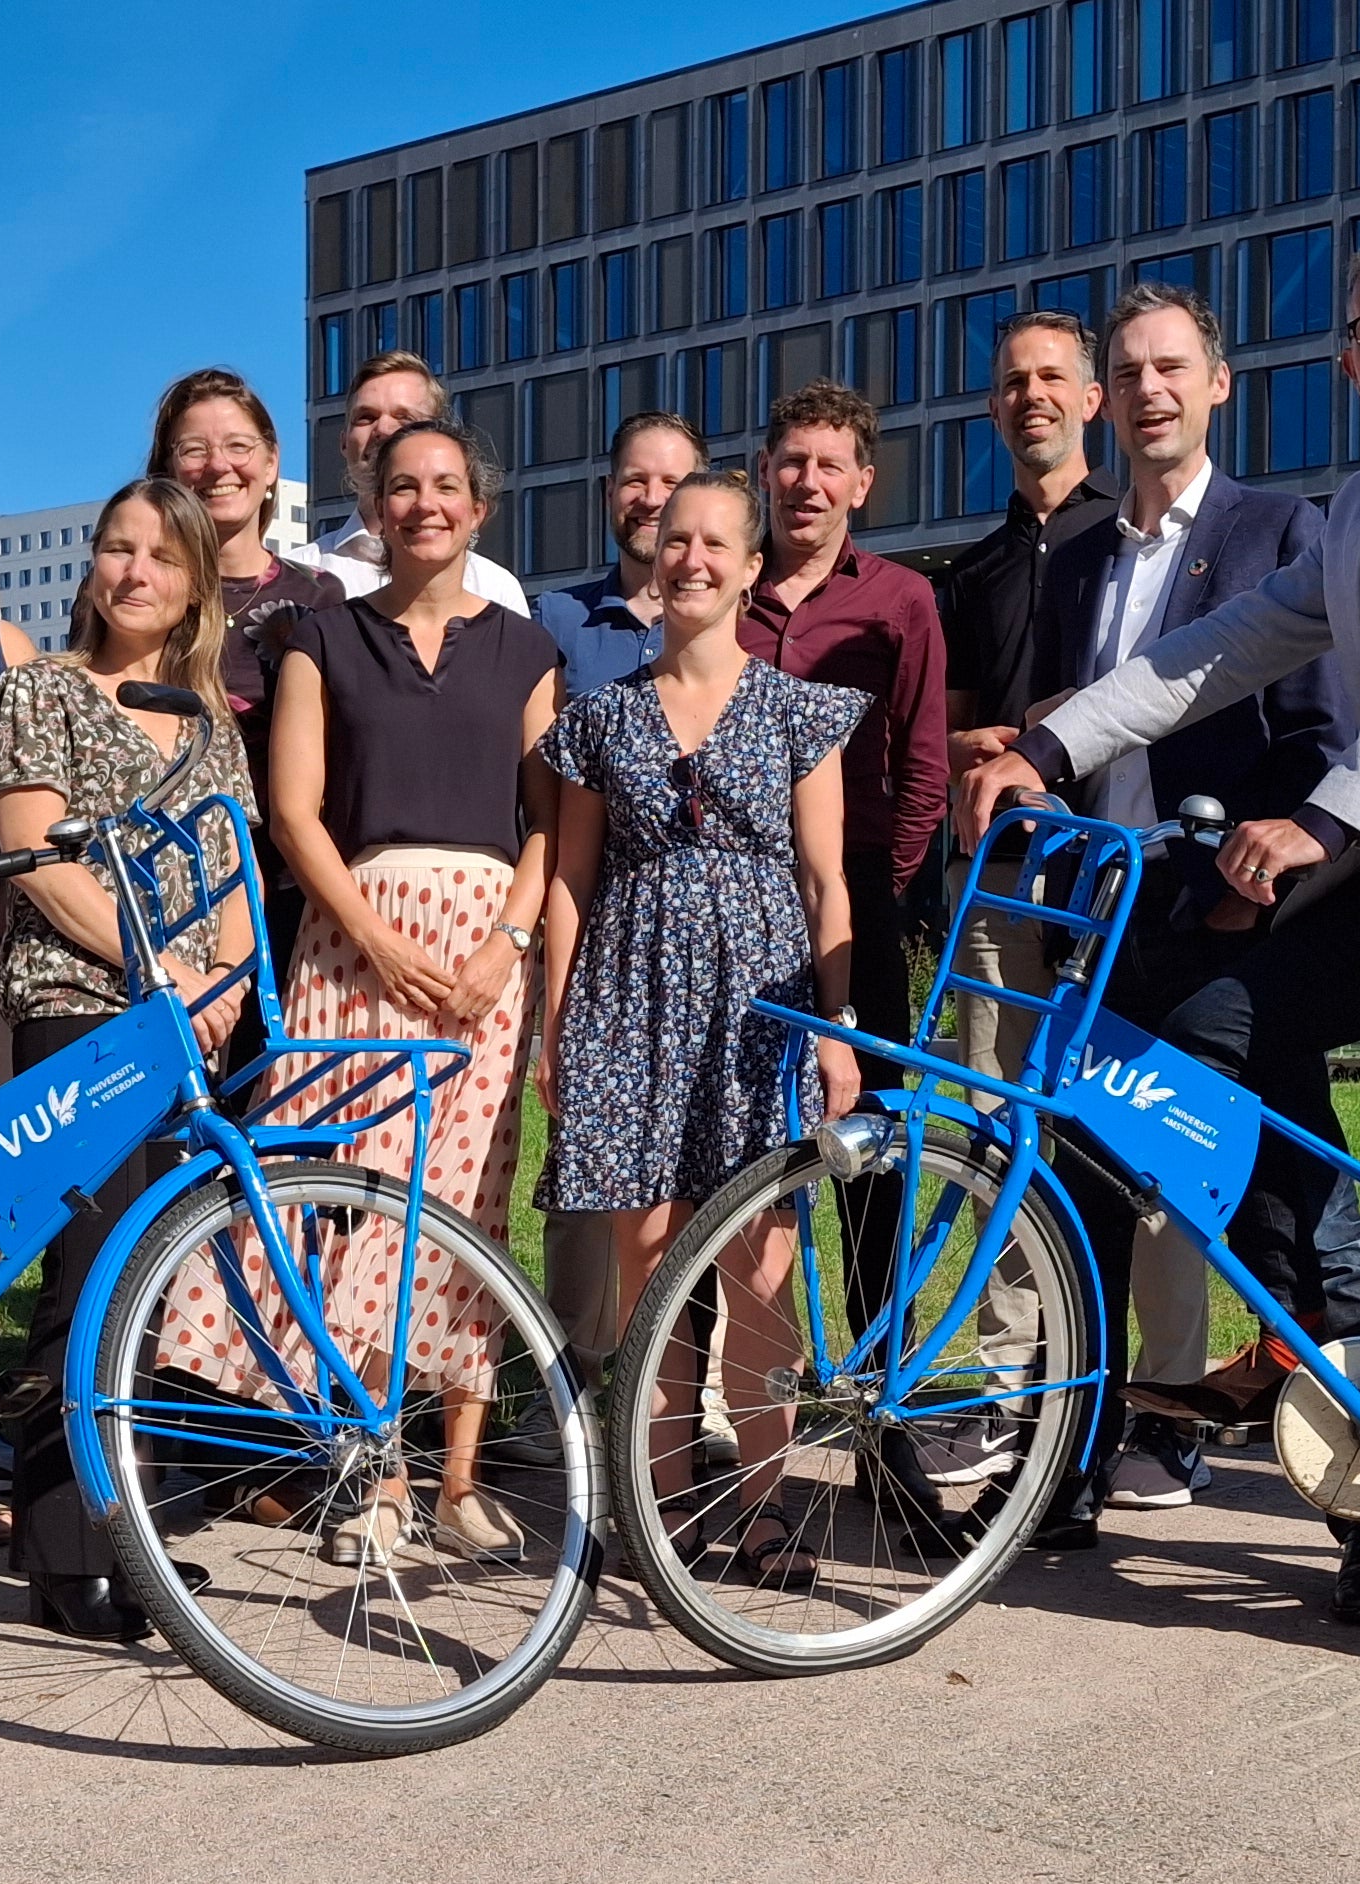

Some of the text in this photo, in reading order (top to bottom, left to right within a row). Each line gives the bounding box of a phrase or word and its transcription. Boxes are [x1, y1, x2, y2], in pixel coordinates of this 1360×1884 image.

[87, 1040, 114, 1064] 2
[85, 1062, 136, 1097] UNIVERSITY
[1082, 1043, 1138, 1097] VU
[1161, 1116, 1218, 1151] AMSTERDAM
[1167, 1104, 1219, 1137] UNIVERSITY
